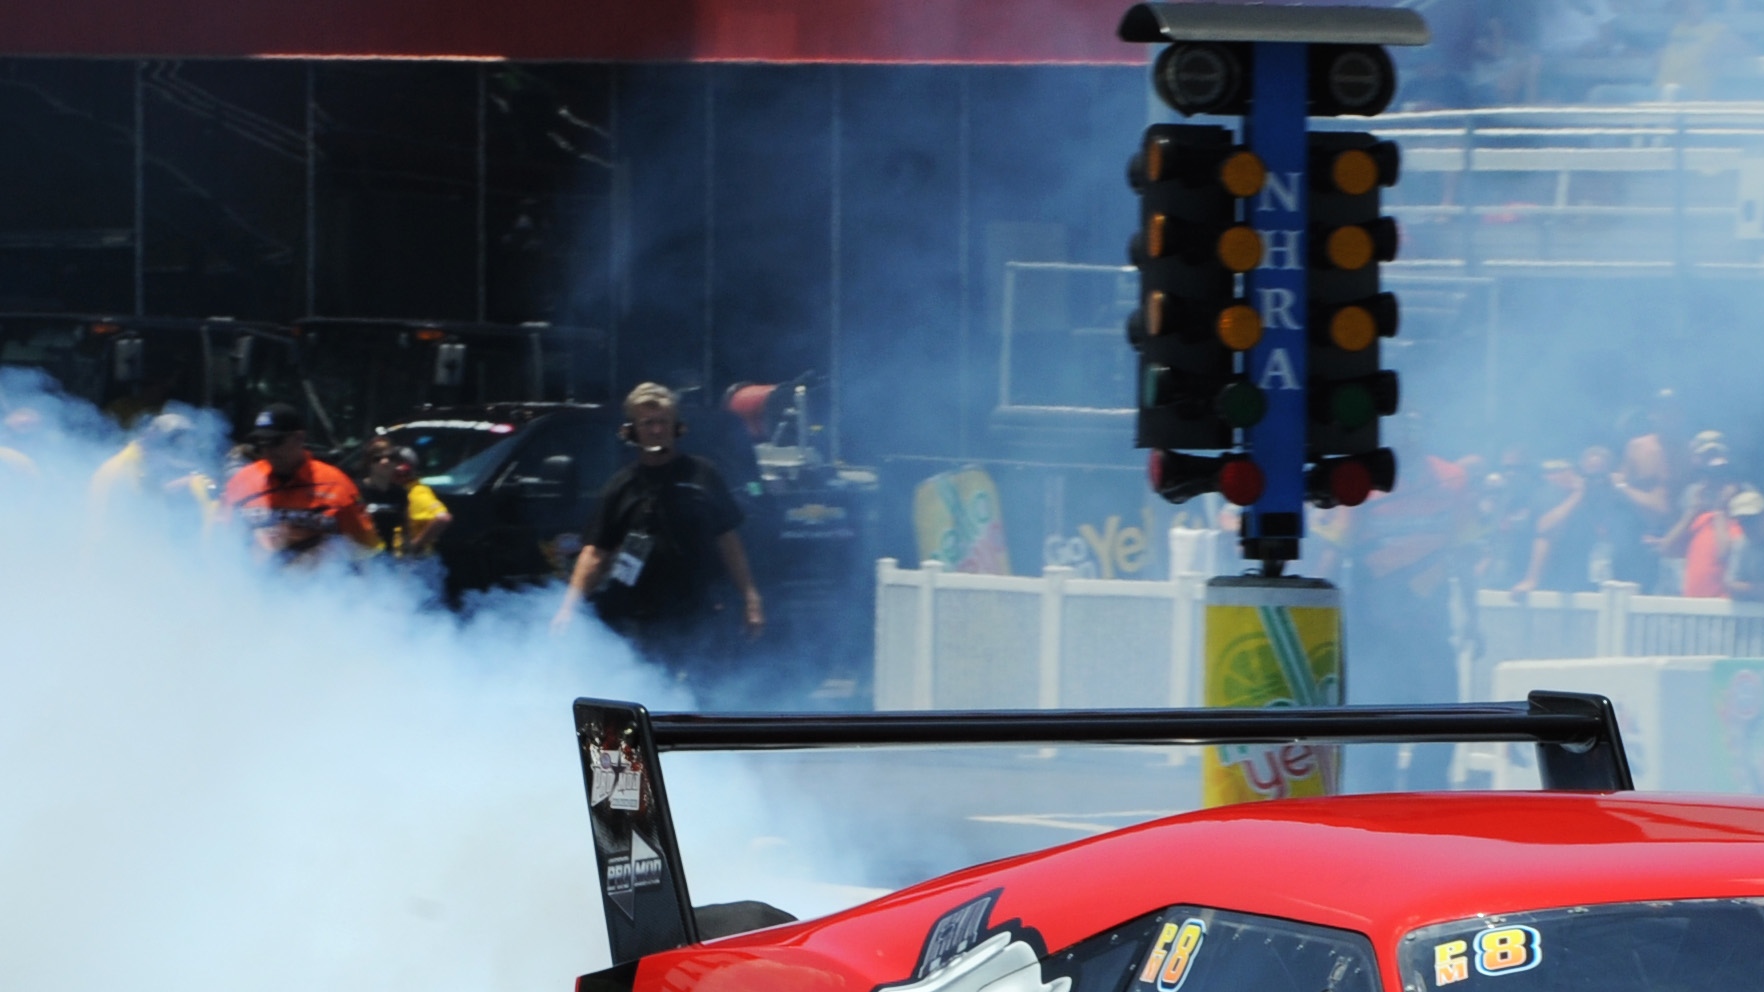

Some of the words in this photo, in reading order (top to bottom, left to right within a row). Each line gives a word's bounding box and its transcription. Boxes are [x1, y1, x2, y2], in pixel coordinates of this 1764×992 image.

[1258, 170, 1304, 392] NHRA
[1160, 920, 1204, 989] 8
[1477, 926, 1538, 974] 8
